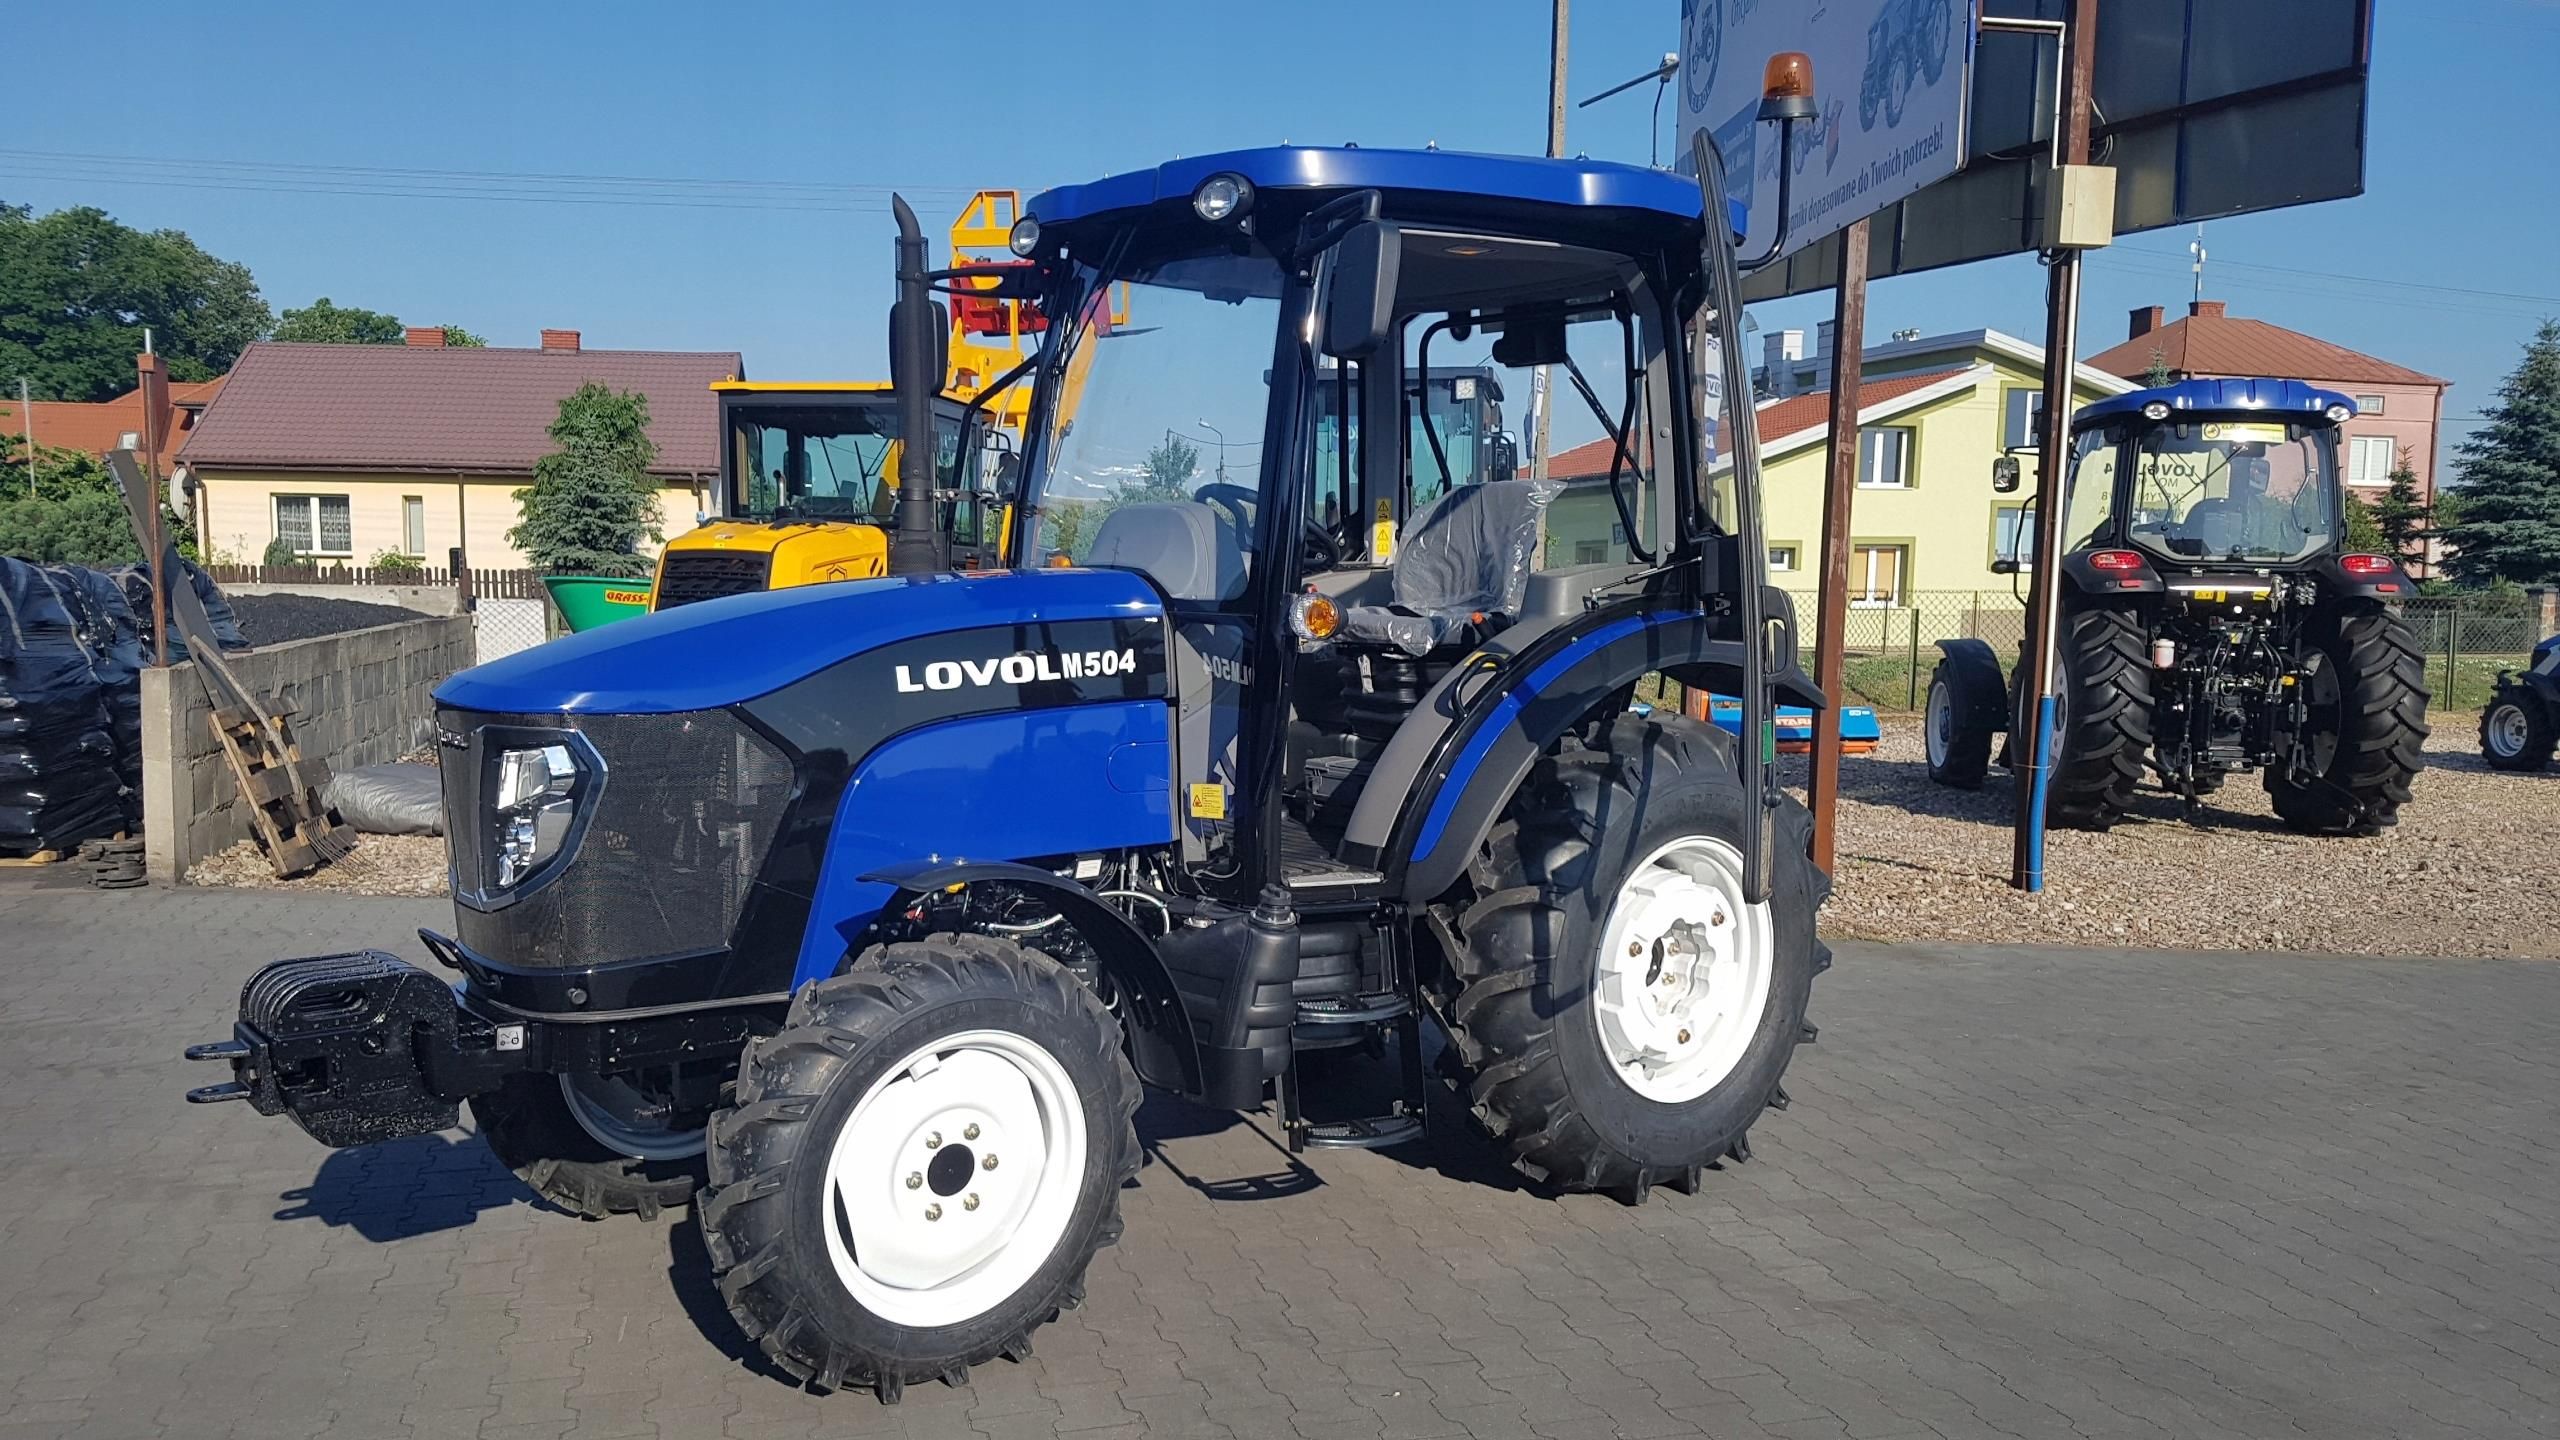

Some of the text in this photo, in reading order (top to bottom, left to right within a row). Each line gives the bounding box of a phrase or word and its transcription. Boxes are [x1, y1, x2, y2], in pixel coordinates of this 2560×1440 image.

[1808, 178, 1857, 224] dopasowane
[1857, 167, 1869, 193] do
[1871, 151, 1901, 187] Twoich
[1902, 122, 1943, 177] potrzeb!
[896, 648, 1136, 692] LOVOL M504
